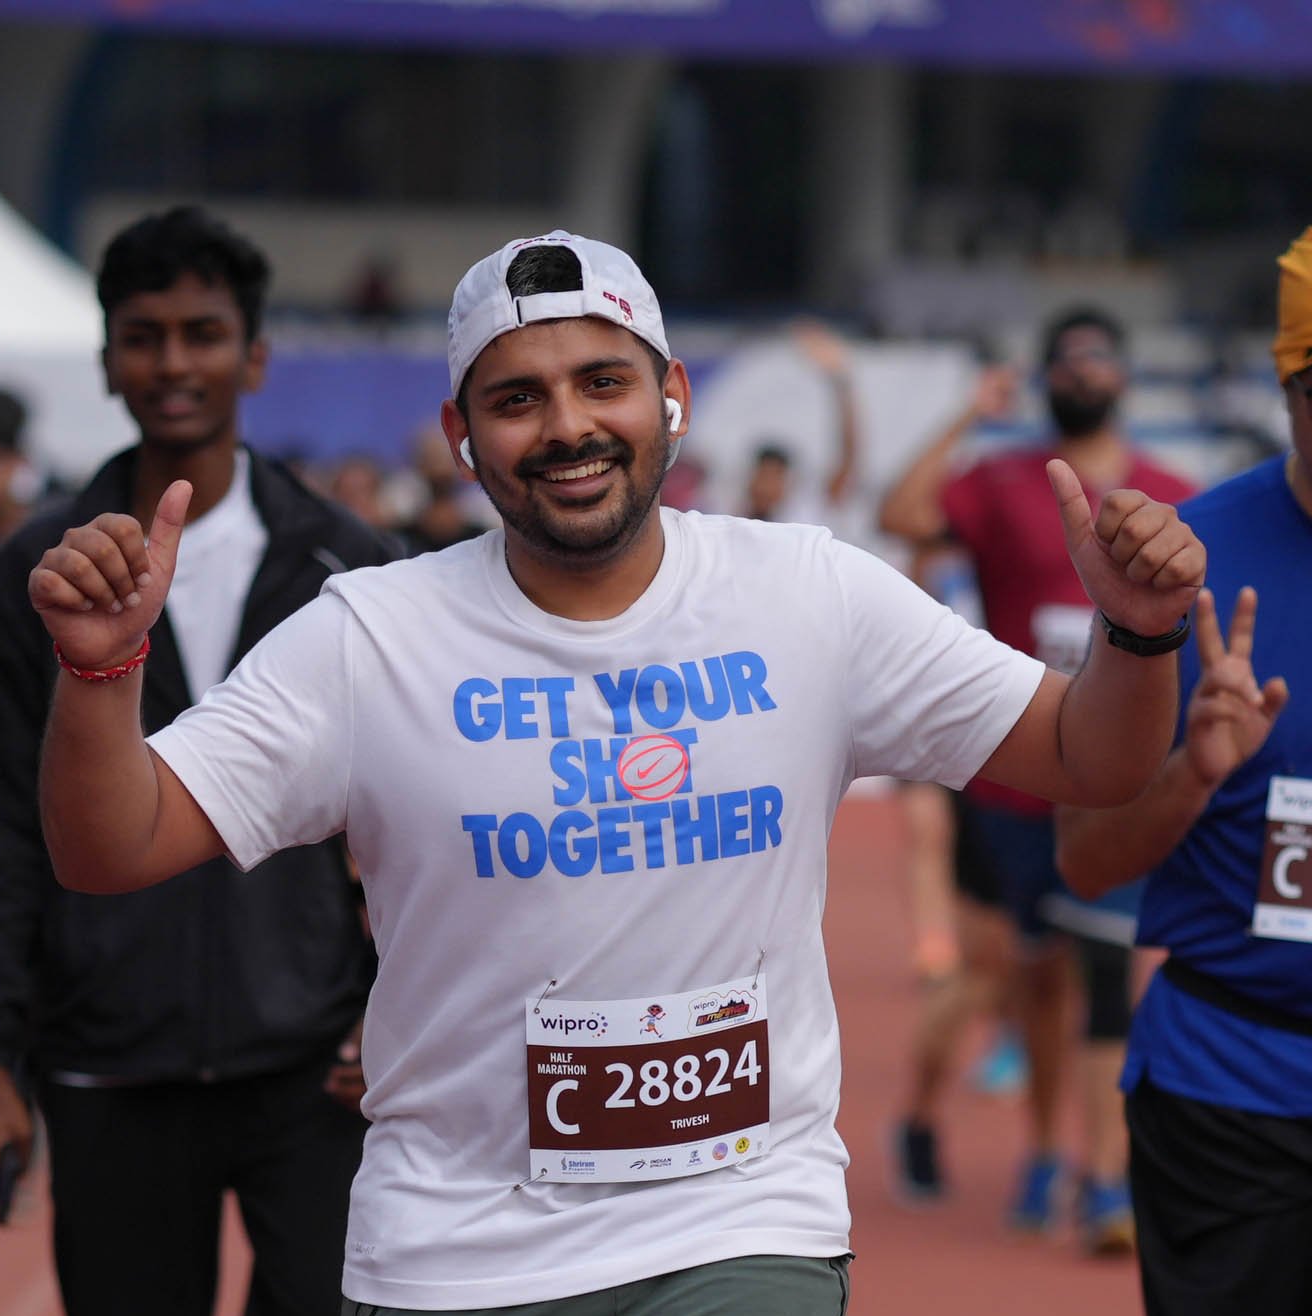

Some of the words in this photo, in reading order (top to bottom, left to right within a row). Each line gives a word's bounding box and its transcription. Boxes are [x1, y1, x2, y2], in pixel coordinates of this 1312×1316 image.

[453, 677, 575, 742] GET
[593, 650, 778, 735] YOUR
[549, 727, 698, 806] SHT
[461, 785, 784, 879] TOGETHER
[1272, 846, 1308, 899] C
[541, 1014, 598, 1035] wipro
[537, 1063, 587, 1076] MARATHON
[550, 1052, 574, 1064] HALF
[546, 1079, 581, 1136] C
[604, 1039, 762, 1109] 28824
[671, 1114, 710, 1130] TRIVESH
